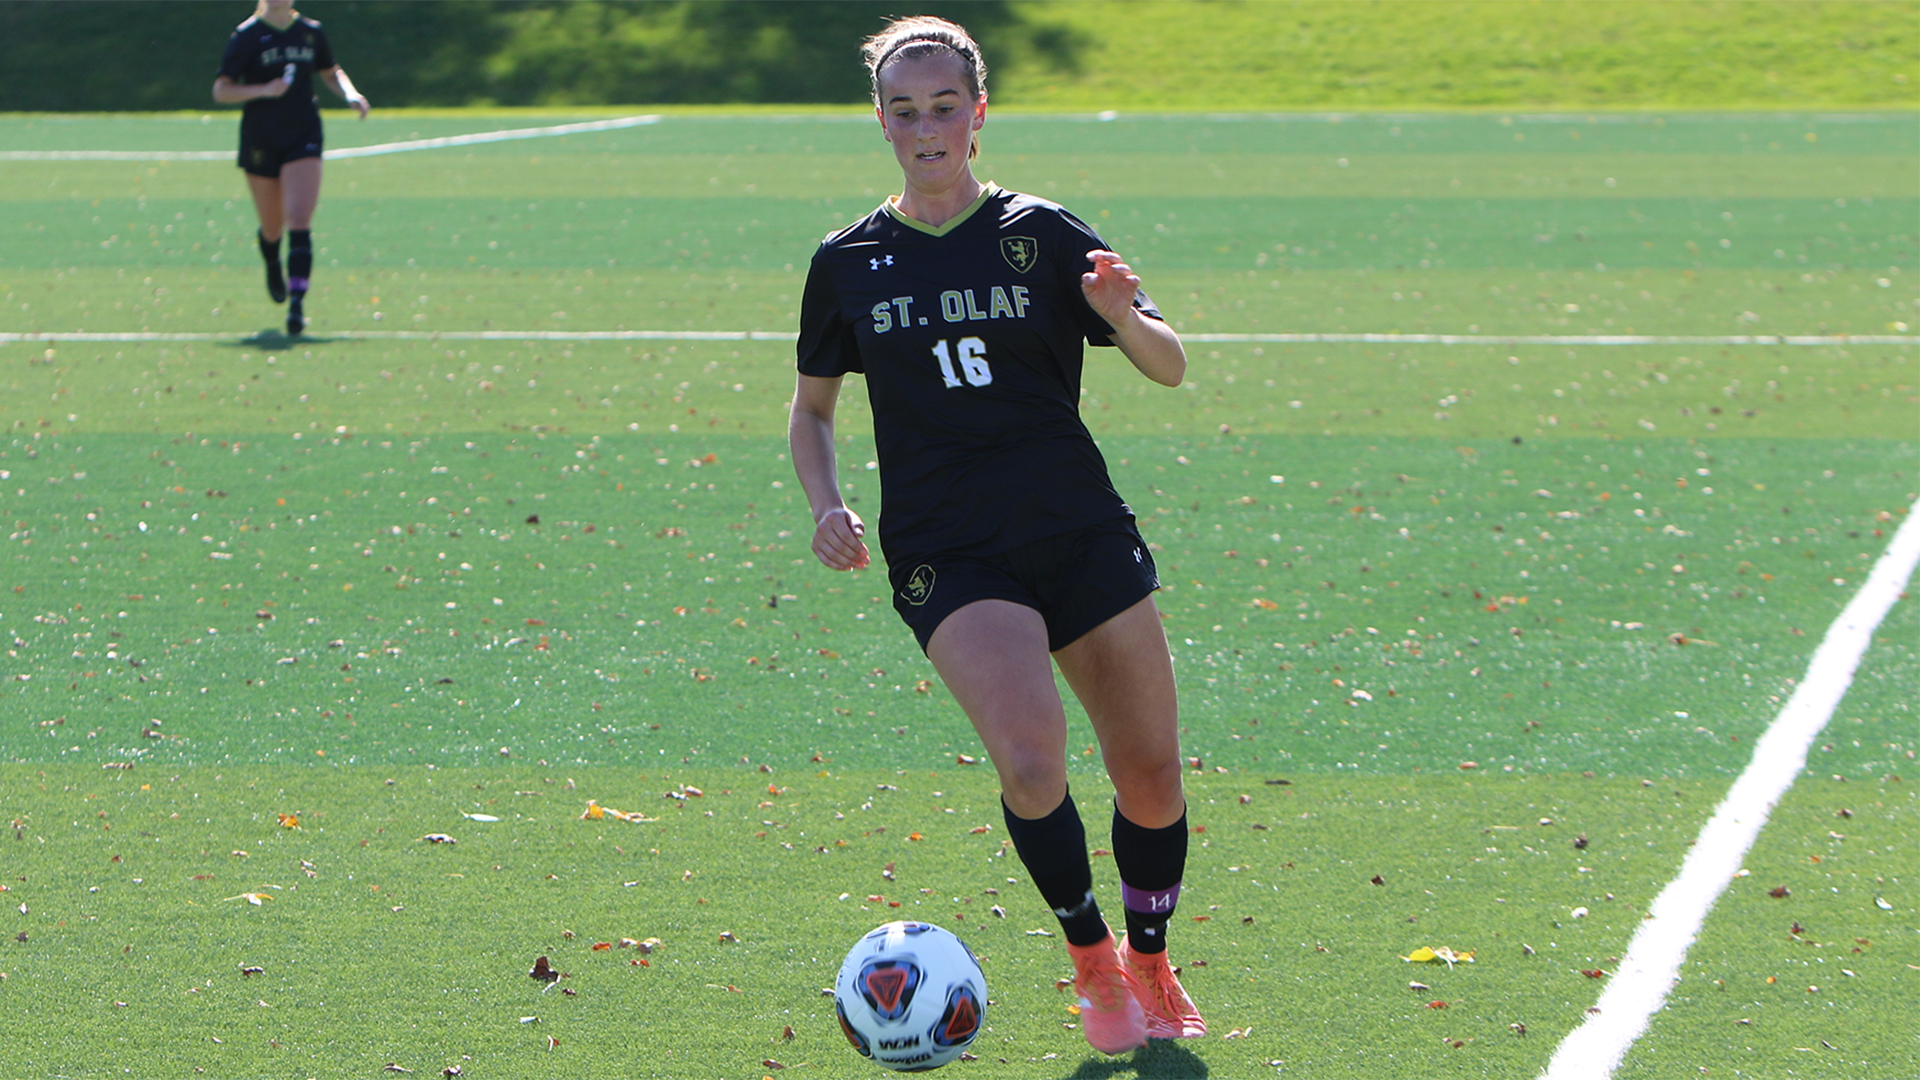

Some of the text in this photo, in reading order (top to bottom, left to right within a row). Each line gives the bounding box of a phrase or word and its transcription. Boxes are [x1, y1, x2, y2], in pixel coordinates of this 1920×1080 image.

[871, 285, 1030, 334] ST. OLAF
[931, 336, 993, 389] 16
[1148, 893, 1170, 911] 14
[879, 1034, 919, 1050] NCAA
